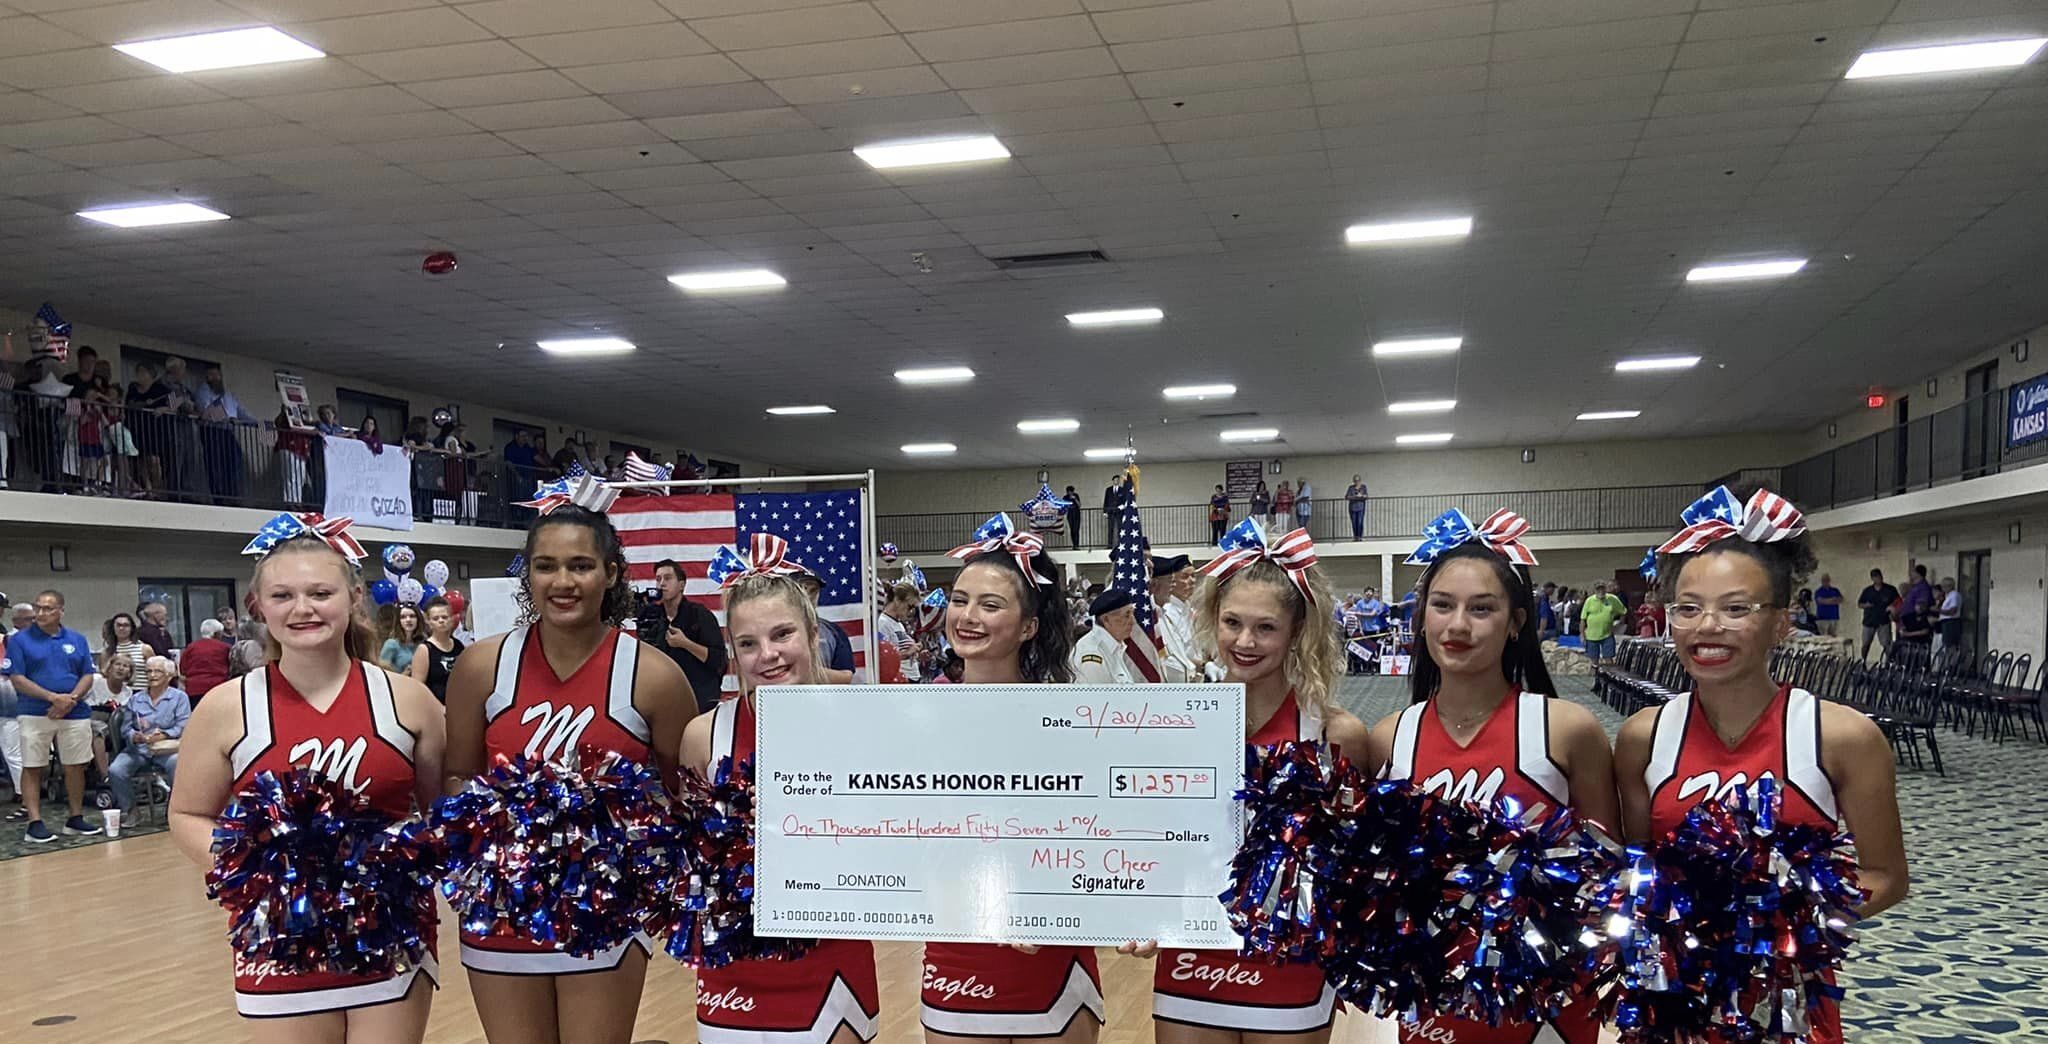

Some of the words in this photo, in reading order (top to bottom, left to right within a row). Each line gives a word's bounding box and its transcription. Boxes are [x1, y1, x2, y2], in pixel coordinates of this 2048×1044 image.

[2012, 411, 2045, 441] KANSAS
[1185, 700, 1219, 711] 5719
[1042, 717, 1072, 728] Date
[1075, 701, 1195, 739] 9/20/2023
[288, 736, 372, 796] M
[774, 771, 796, 784] Pay
[799, 772, 810, 782] to
[813, 771, 833, 782] the
[848, 773, 927, 790] KANSAS
[932, 774, 1006, 791] HONOR
[1011, 774, 1084, 791] FLIGHT
[783, 785, 818, 796] Order
[820, 785, 833, 796] of
[782, 814, 815, 839] One
[817, 818, 881, 845] Thousand
[880, 818, 907, 835] Two
[907, 818, 961, 840] Hundred
[966, 813, 1000, 843] Fifty
[1004, 817, 1049, 837] Seven
[1165, 830, 1210, 843] Dollars
[1031, 848, 1086, 870] MHS
[1103, 847, 1160, 878] Cheer
[784, 879, 821, 891] Memo
[837, 874, 907, 888] DONATION
[1071, 874, 1146, 893] Signature
[1184, 920, 1218, 932] 2100
[1171, 951, 1264, 991] Eagles
[922, 964, 997, 1000] Eagles
